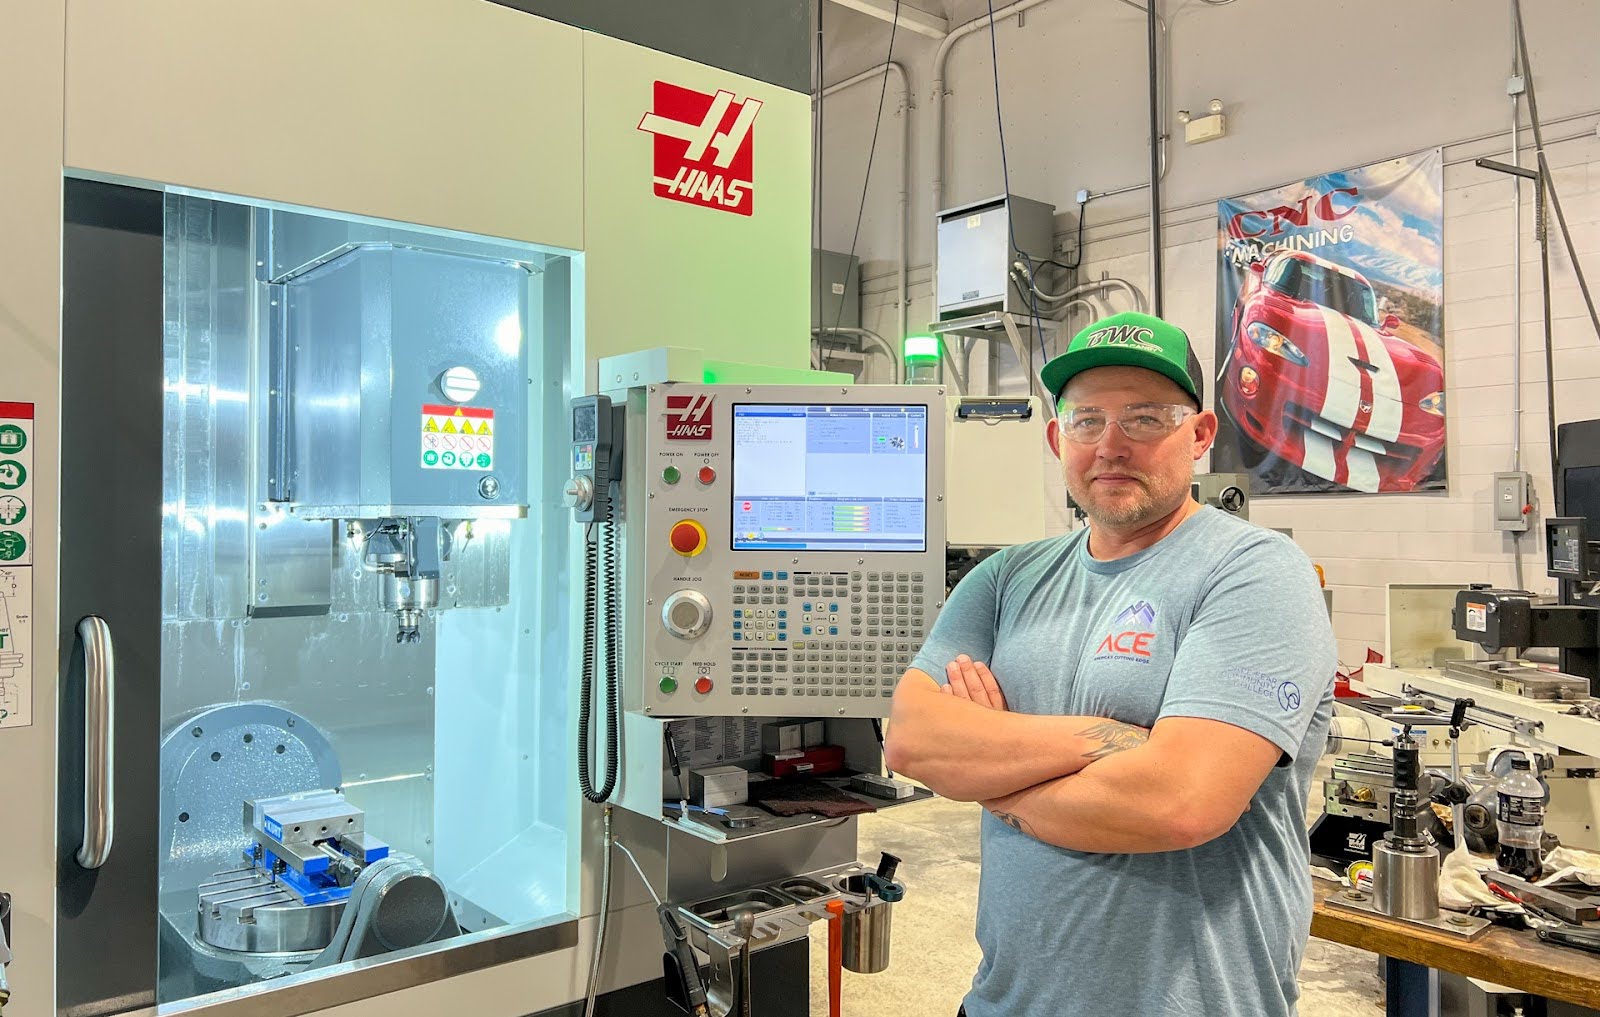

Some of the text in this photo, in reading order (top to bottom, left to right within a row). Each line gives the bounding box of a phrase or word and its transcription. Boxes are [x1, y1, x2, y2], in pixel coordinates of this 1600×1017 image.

[654, 166, 752, 207] HAAS
[1228, 187, 1358, 239] CNC
[1231, 224, 1354, 263] MACHINING
[1086, 325, 1160, 349] BWC
[667, 424, 711, 436] HAAS
[1096, 631, 1156, 657] ACE
[268, 819, 282, 838] KURT
